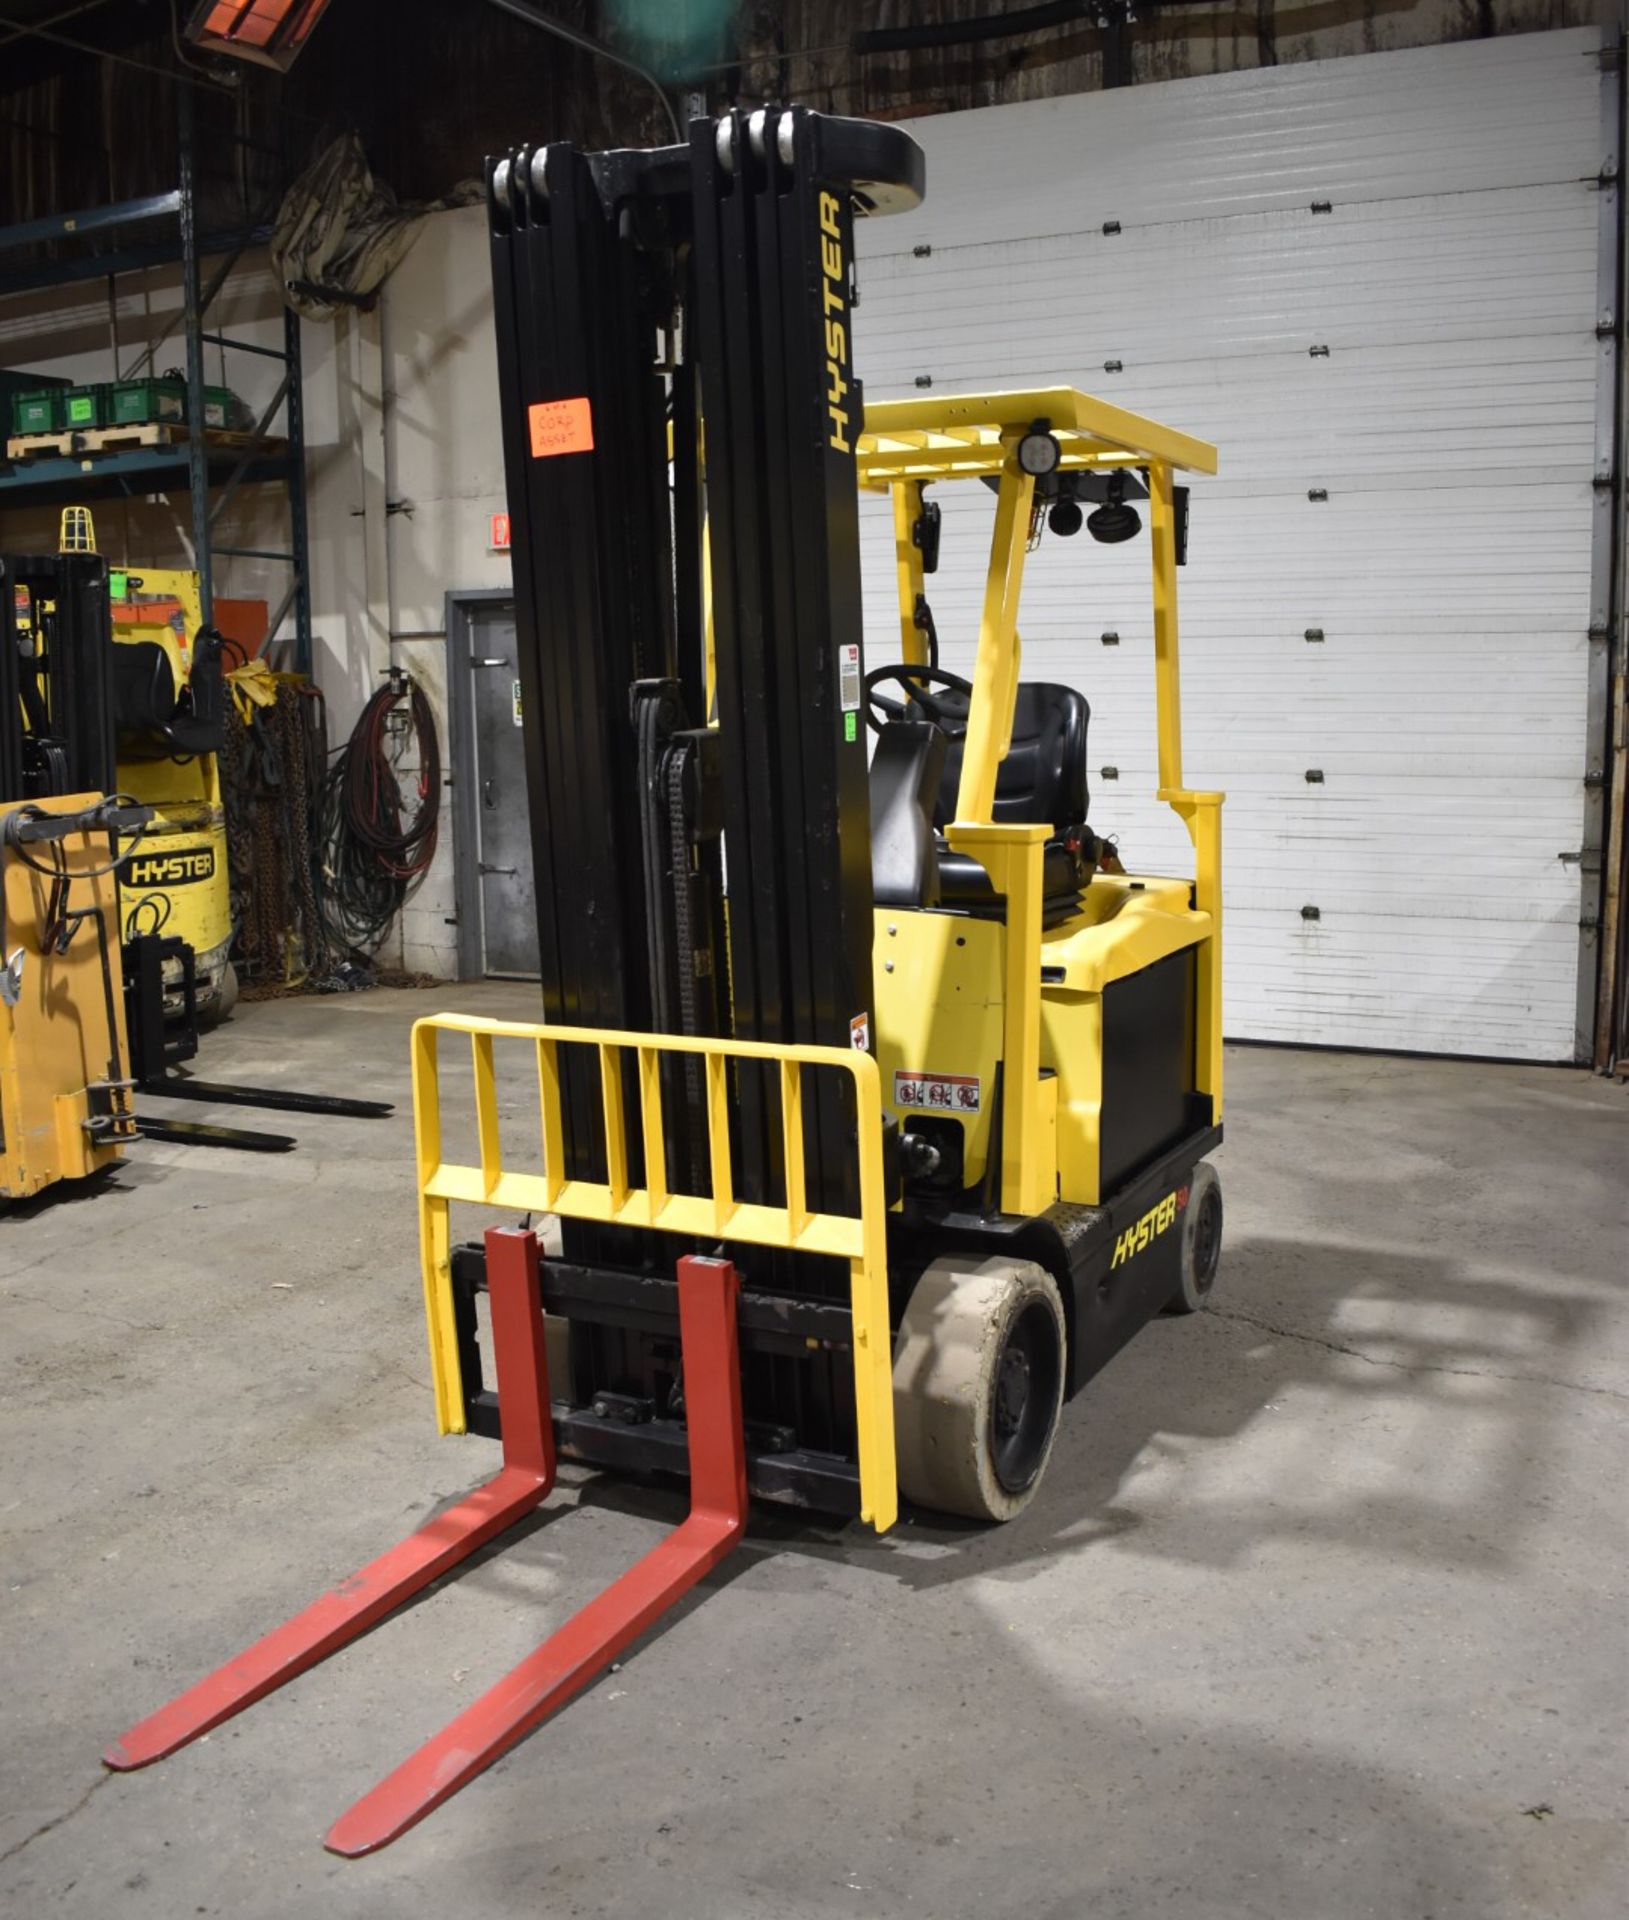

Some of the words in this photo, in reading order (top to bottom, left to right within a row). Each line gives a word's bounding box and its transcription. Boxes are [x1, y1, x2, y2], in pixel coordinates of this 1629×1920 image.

[819, 191, 850, 454] HYSTER
[539, 415, 575, 430] CORP
[131, 853, 212, 884] HYSTER
[1110, 1191, 1176, 1270] HYSTER
